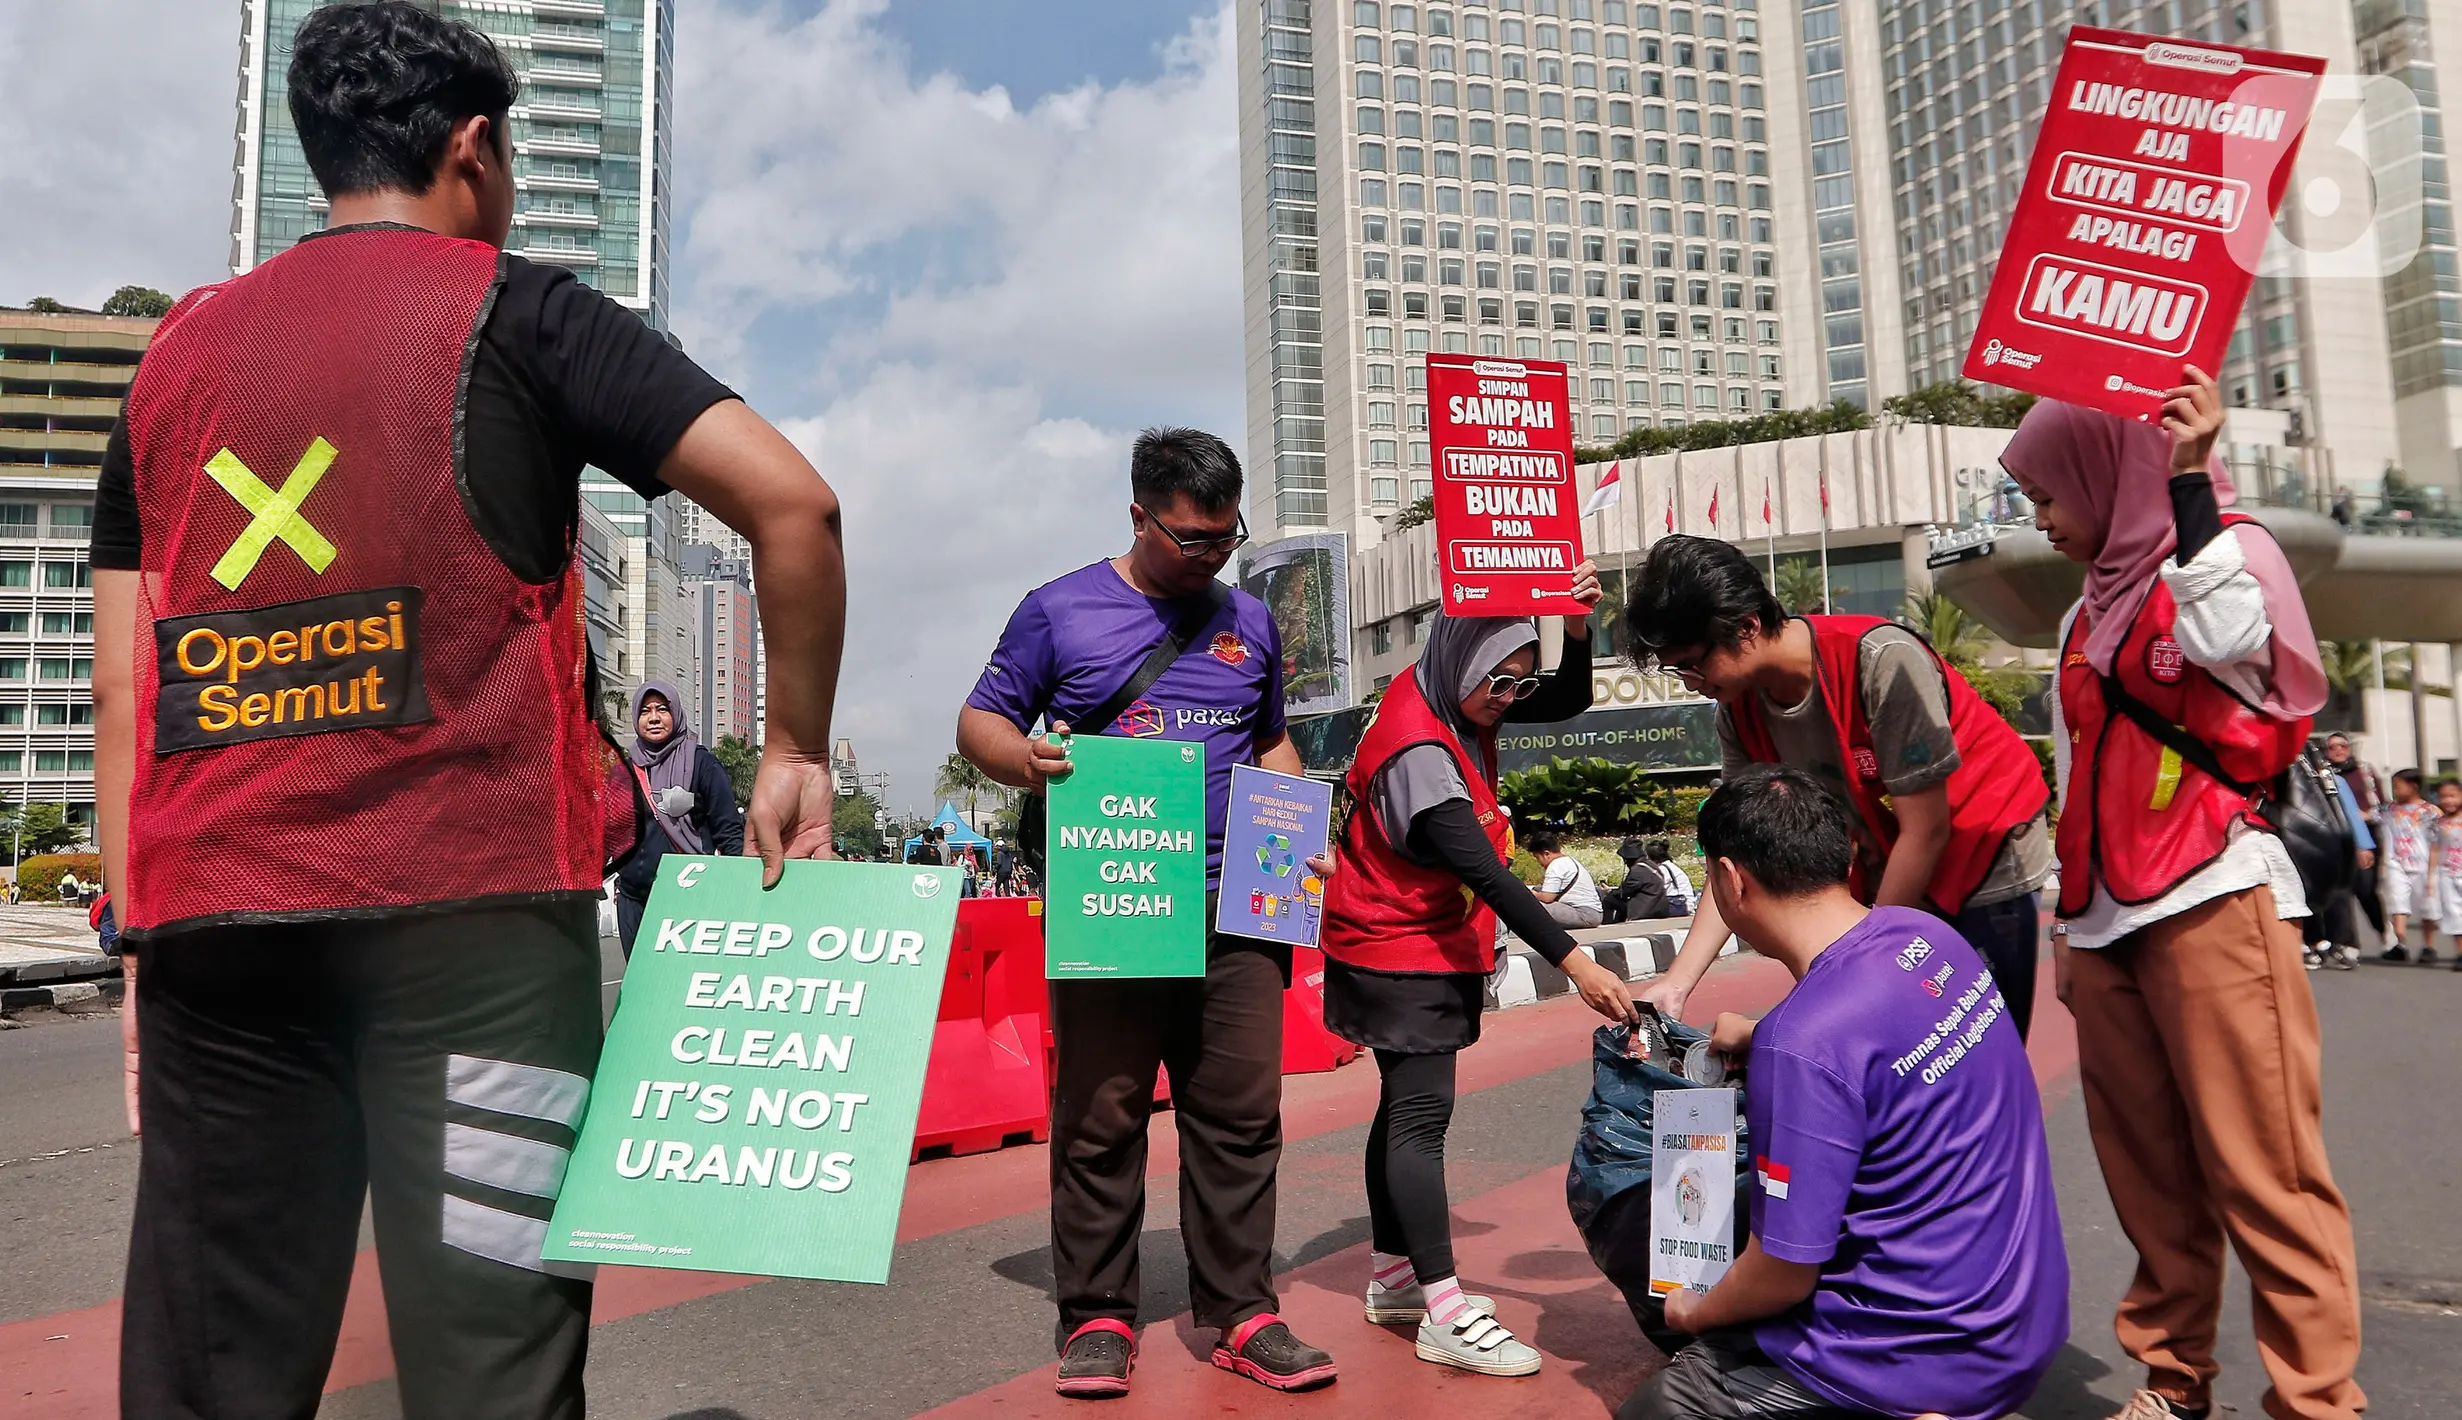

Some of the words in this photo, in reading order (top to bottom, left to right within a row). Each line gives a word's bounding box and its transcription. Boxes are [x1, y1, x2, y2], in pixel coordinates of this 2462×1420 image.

[2162, 49, 2202, 61] Operasi
[2204, 55, 2237, 67] Semut
[2067, 79, 2286, 142] LINGKUNGAN
[2133, 129, 2191, 162] AJA
[2061, 162, 2138, 205] KITA
[2144, 179, 2238, 223] JAGA
[2068, 213, 2198, 263] APALAGI
[2029, 265, 2196, 342] KAMU
[2001, 355, 2033, 369] Semut
[2004, 347, 2043, 363] Operasi
[1477, 379, 1529, 397] SIMPAN
[1449, 395, 1554, 428] SAMPAH
[1487, 429, 1529, 447] PADA
[1447, 453, 1559, 478] TEMPATNYA
[1465, 485, 1558, 517] BUKAN
[1491, 520, 1534, 537] PADA
[1461, 546, 1565, 569] TEMANNYA
[1464, 586, 1490, 594] Operasi
[176, 600, 405, 684] Operasi
[196, 665, 387, 733] Semut
[1593, 674, 1701, 706] DONE
[1495, 735, 1557, 751] EYOND
[1561, 726, 1686, 747] OUT-OF-HOME
[1099, 795, 1158, 819] GAK
[1059, 826, 1194, 852] NYAMPAH
[1099, 860, 1158, 884] GAK
[1081, 892, 1174, 918] SUSAH
[653, 918, 793, 957] KEEP
[807, 925, 926, 966] OUR
[1902, 935, 1933, 965] PSSI
[1934, 961, 1956, 988] paxel
[684, 971, 868, 1016] EARTH
[1891, 1032, 1943, 1077] Timnas
[1935, 1005, 1967, 1037] Sepak
[1957, 989, 1982, 1012] Bola
[1921, 1040, 1968, 1085] Official
[1959, 1008, 1998, 1049] Logistics
[670, 1026, 855, 1072] CLEAN
[629, 1080, 733, 1124] IT'S
[745, 1087, 869, 1132] NOT
[1661, 1133, 1727, 1152] #BIASATANPASISA
[614, 1138, 855, 1193] URANUS
[568, 1240, 595, 1249] social
[595, 1242, 658, 1254] responsibility
[658, 1245, 693, 1256] project
[571, 1230, 635, 1241] cleannovation
[1659, 1237, 1678, 1256] STOP
[1679, 1240, 1699, 1259] FOOD
[1700, 1243, 1728, 1263] WASTE
